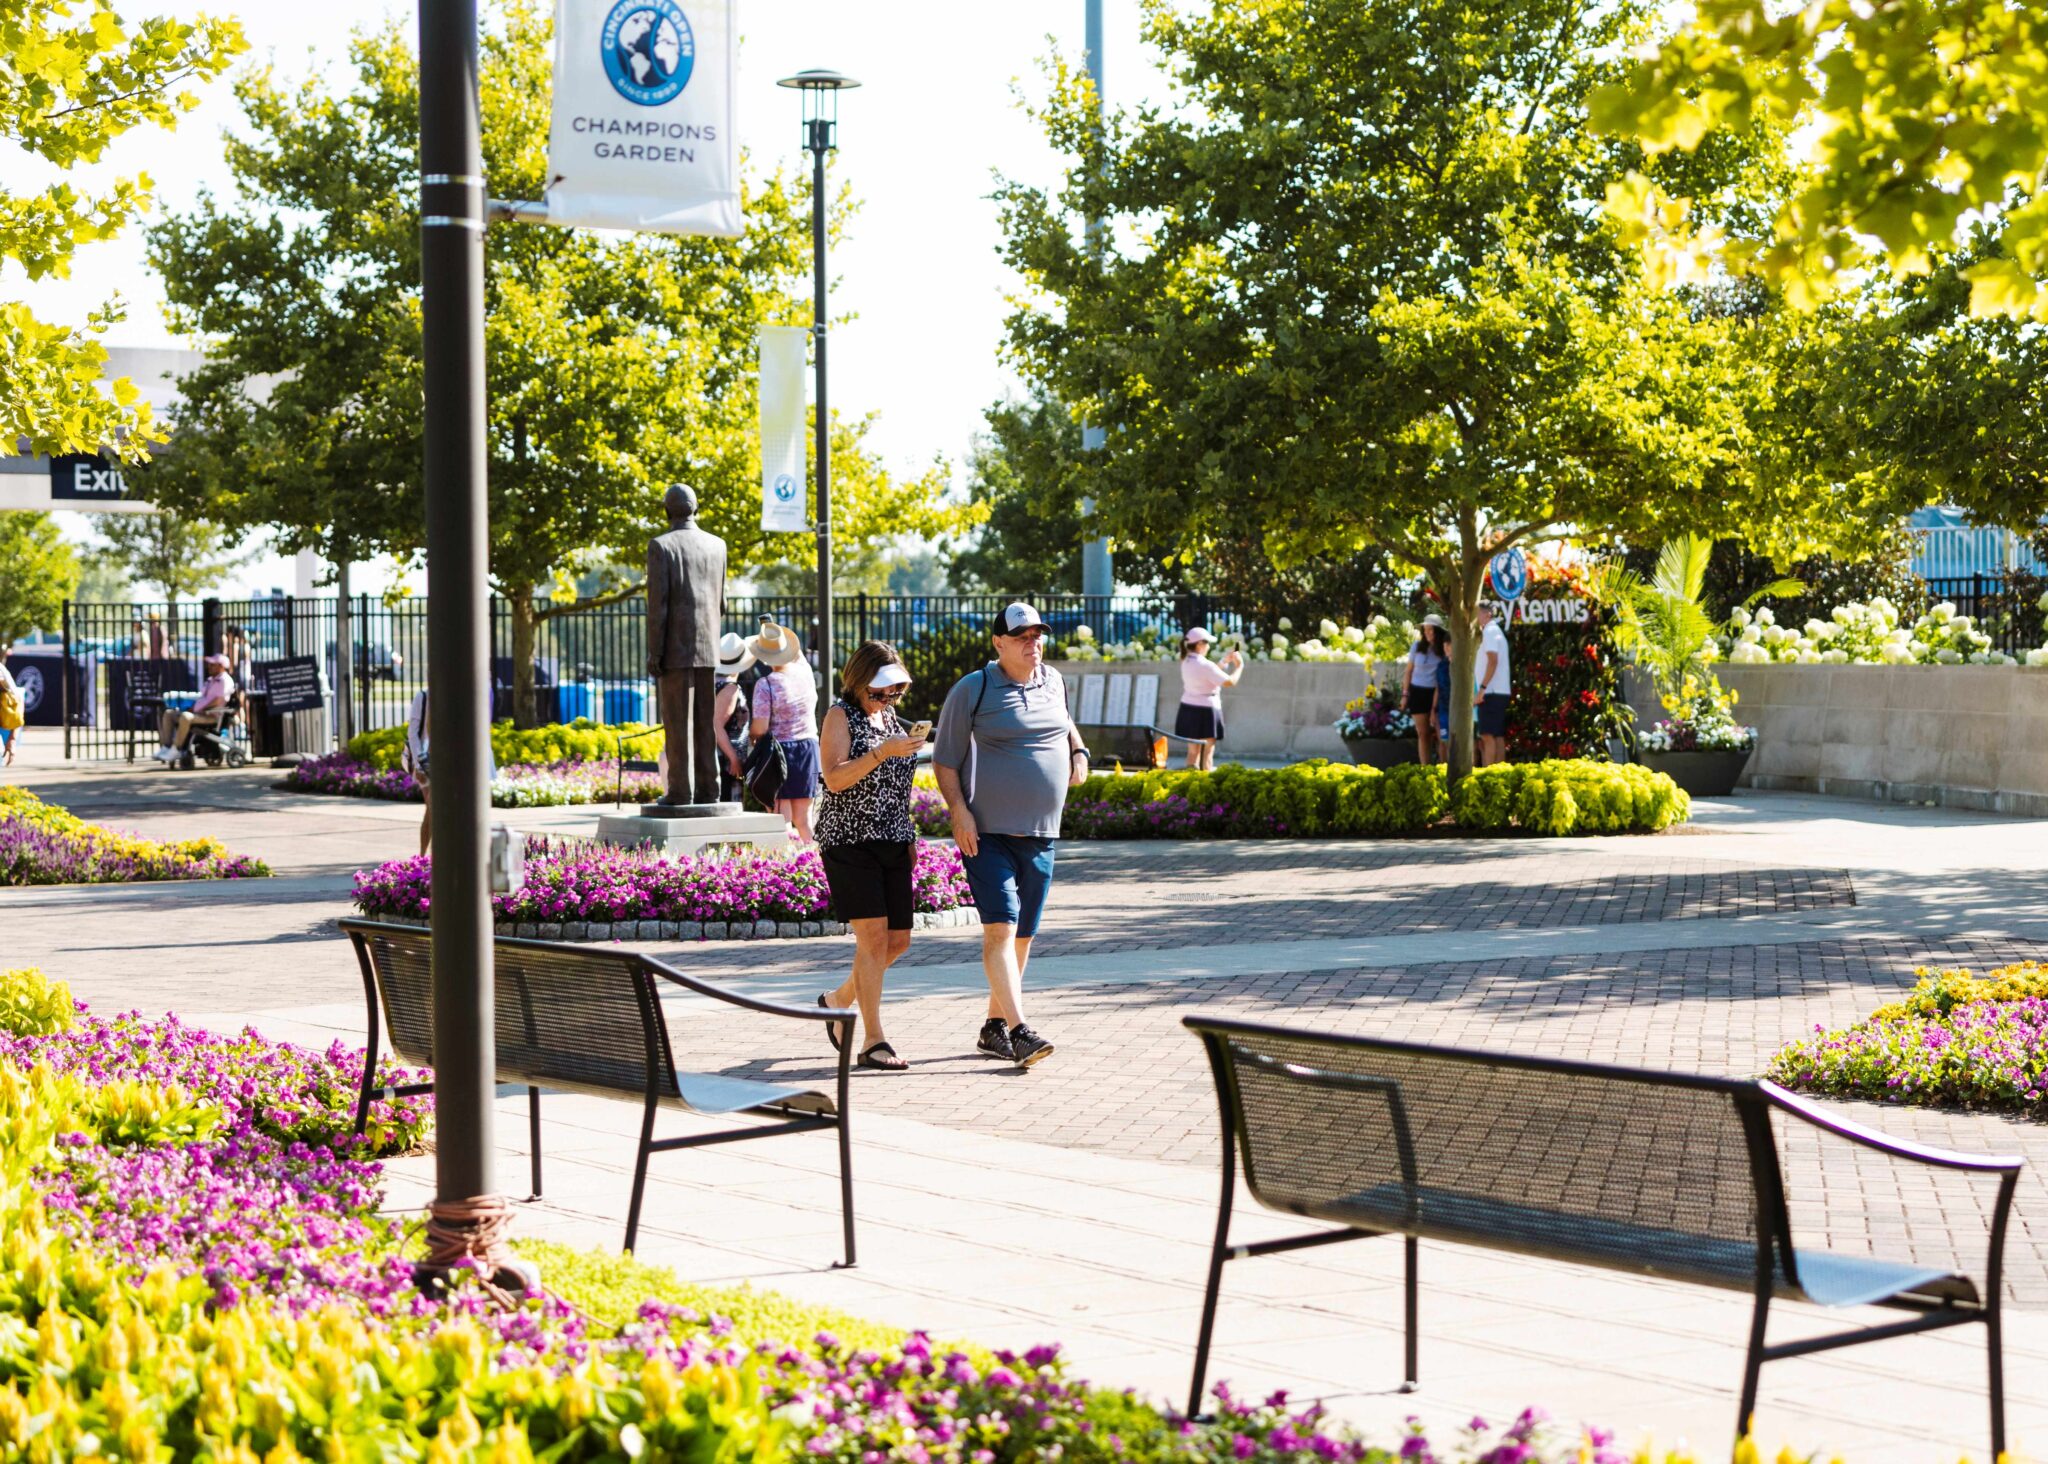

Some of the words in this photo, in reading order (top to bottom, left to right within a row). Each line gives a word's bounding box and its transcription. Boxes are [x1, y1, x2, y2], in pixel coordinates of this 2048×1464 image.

[669, 10, 693, 57] OPEN
[572, 116, 717, 141] CHAMPIONS
[594, 142, 695, 163] GARDEN
[74, 463, 130, 492] Exit
[1519, 595, 1590, 623] tennis
